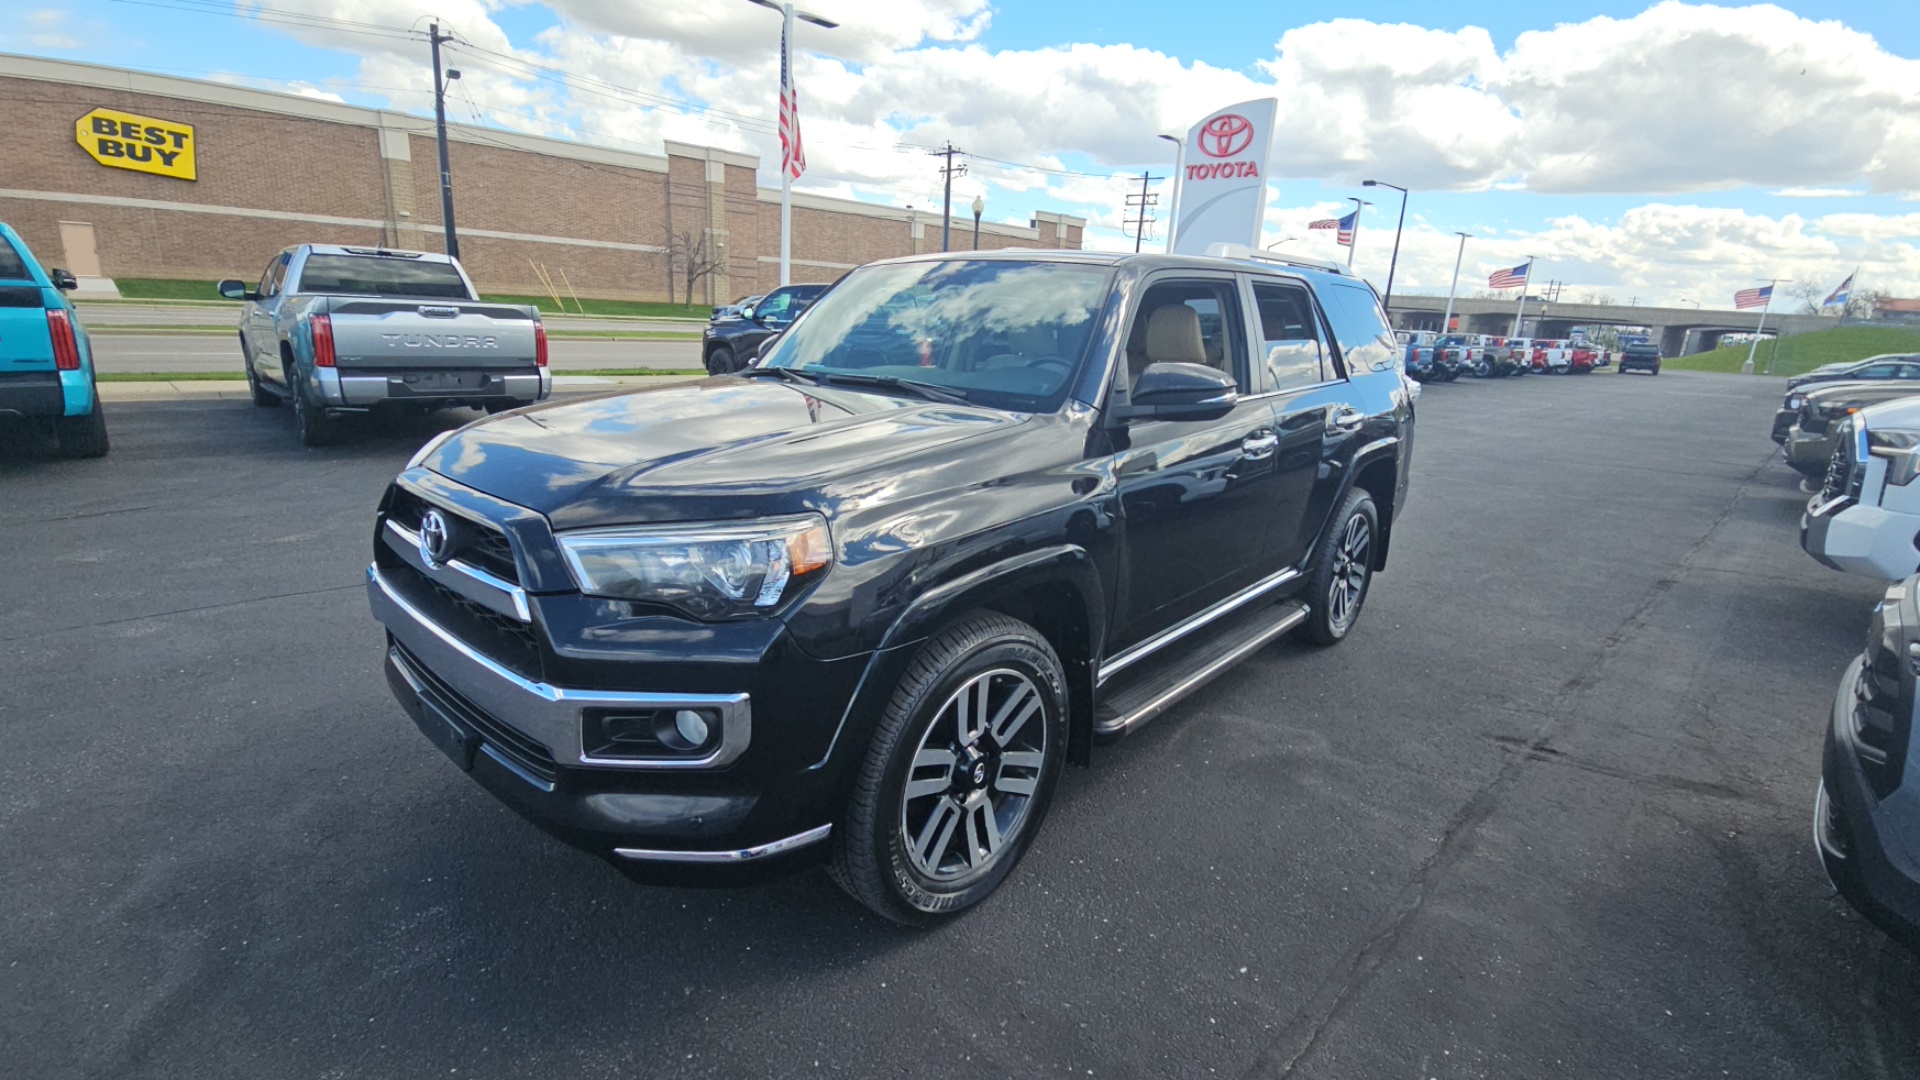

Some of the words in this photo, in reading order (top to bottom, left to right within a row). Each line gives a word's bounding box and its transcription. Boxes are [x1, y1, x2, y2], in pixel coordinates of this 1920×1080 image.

[91, 115, 189, 150] BEST
[98, 137, 182, 168] BUY
[1186, 160, 1259, 181] TOYOTA
[381, 333, 499, 349] TUNDRA
